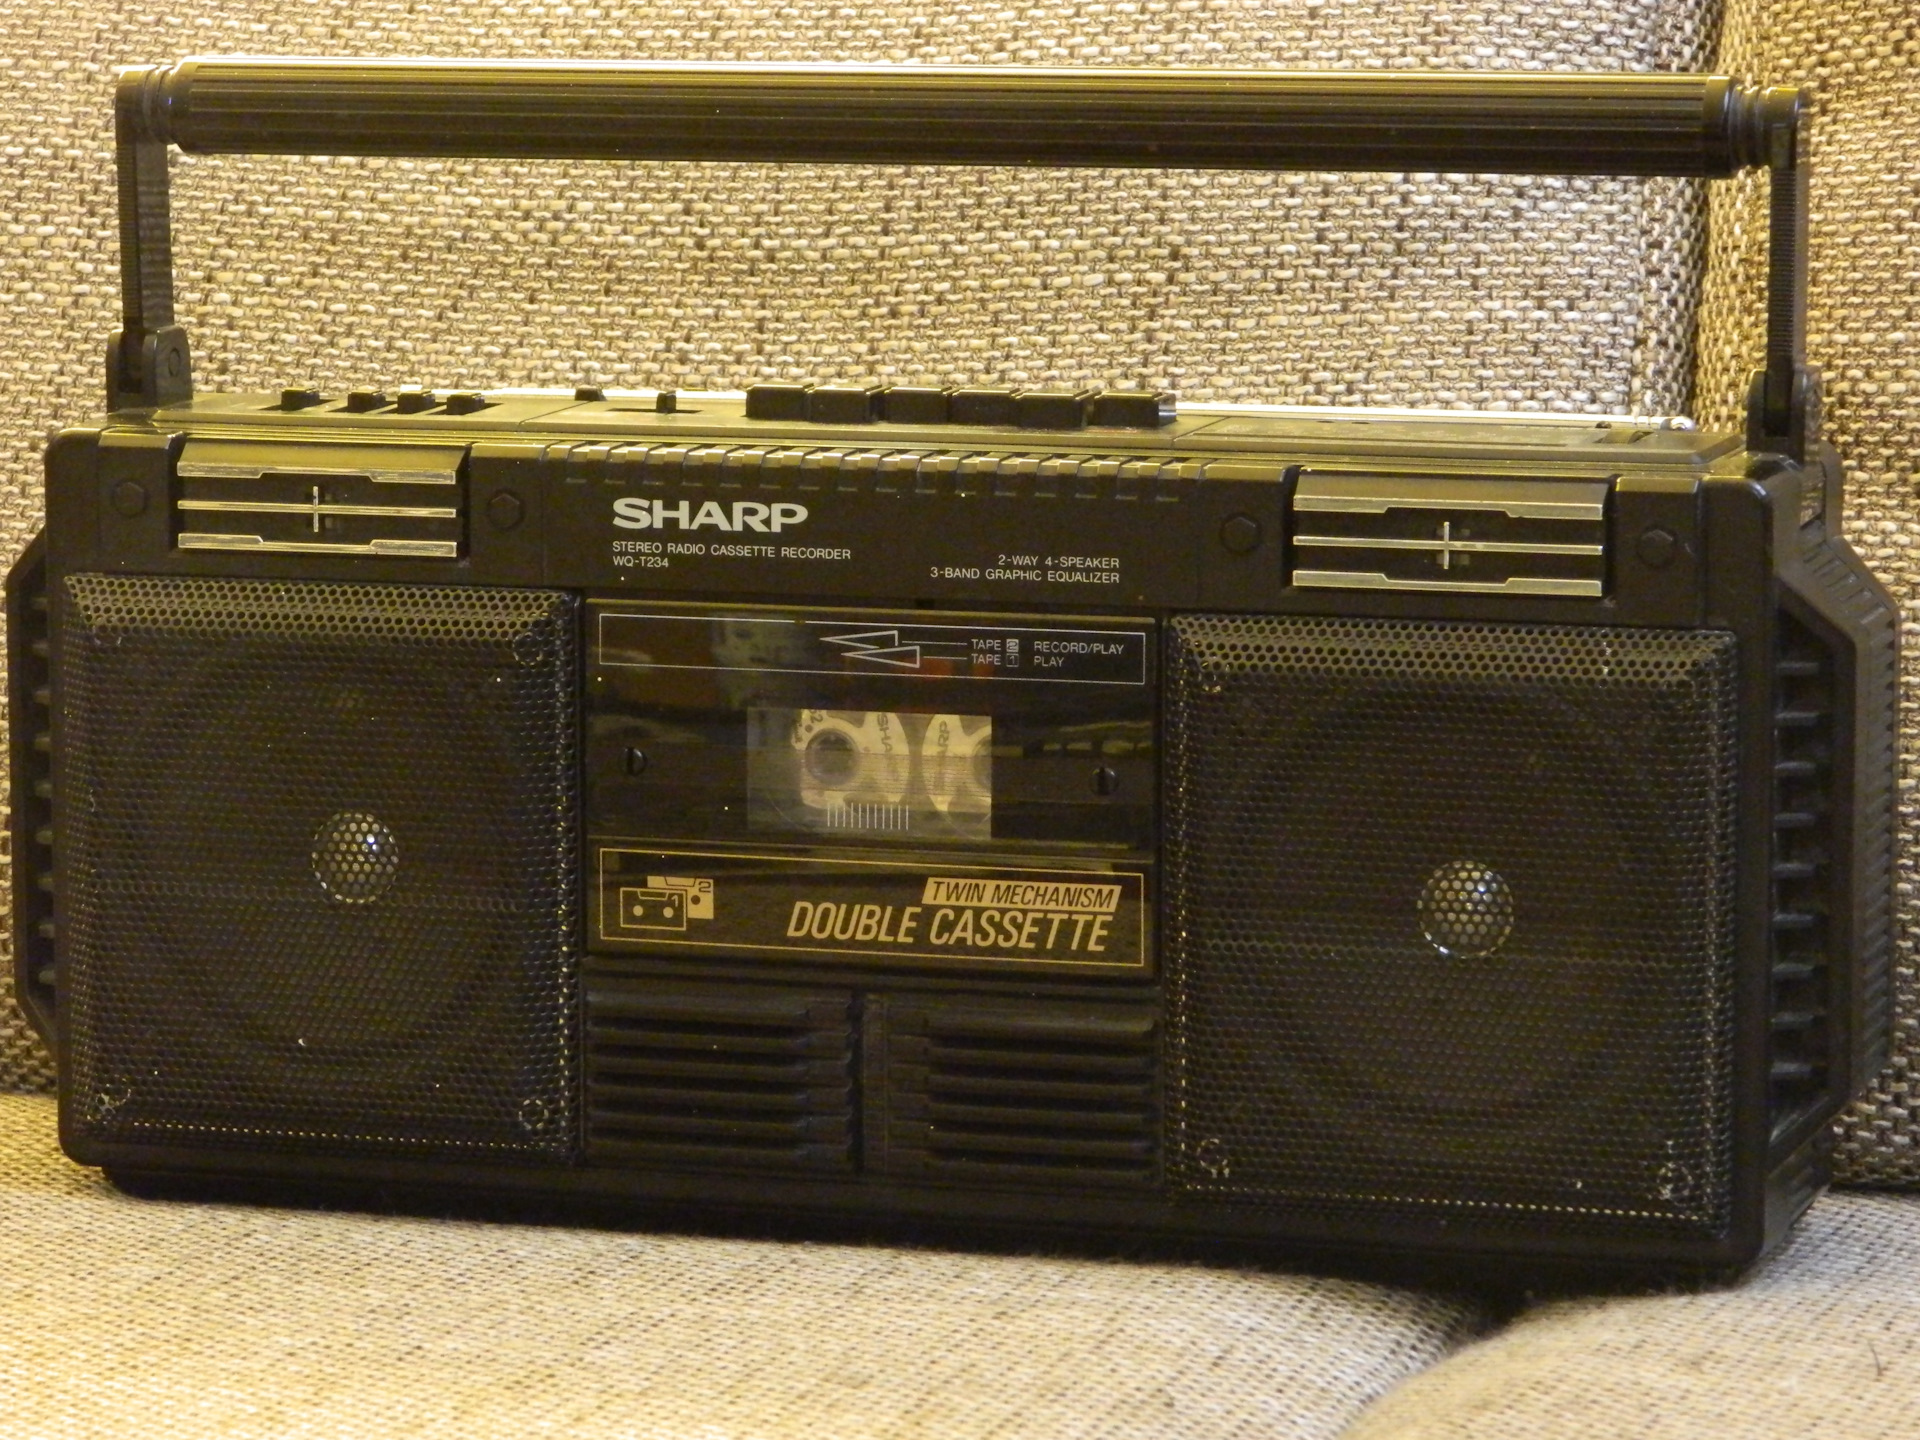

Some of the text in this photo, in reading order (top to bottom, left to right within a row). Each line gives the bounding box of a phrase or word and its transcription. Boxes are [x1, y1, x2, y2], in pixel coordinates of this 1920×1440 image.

[613, 497, 808, 533] SHARP
[612, 541, 851, 560] STEREO RADIO CASSETTE RECORDER
[613, 556, 669, 569] WQ-T234
[998, 554, 1120, 569] 2-WAY 4-SPEAKER
[930, 567, 1120, 584] 3-BAND GRAPHIC EQUALIZER
[971, 639, 1124, 655] TAPE 2 RECORD/PLAY
[971, 653, 1001, 665] TAPE
[1034, 655, 1064, 667] PLAY
[698, 881, 712, 893] 2
[933, 881, 1115, 908] TWIN MECHANISM
[671, 895, 678, 907] 1
[787, 901, 1114, 952] DOUBLE CASSETTE
